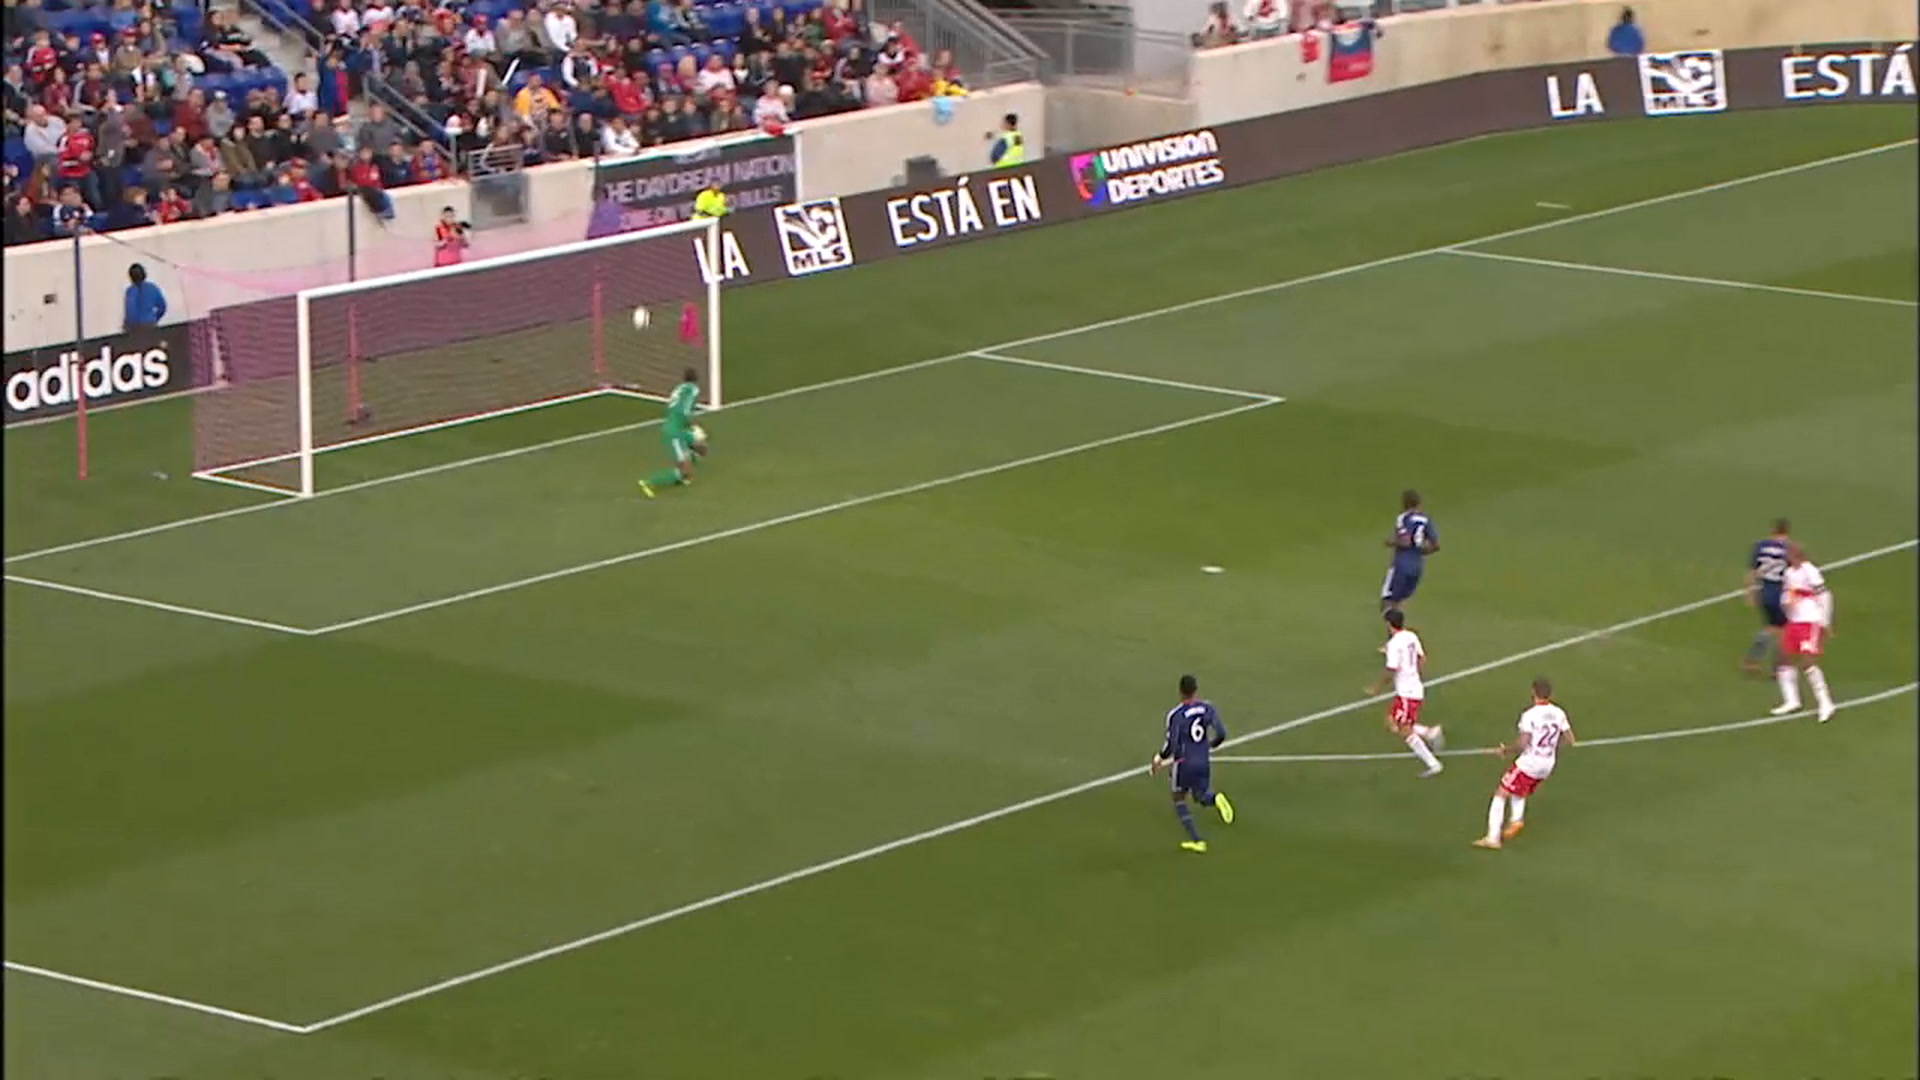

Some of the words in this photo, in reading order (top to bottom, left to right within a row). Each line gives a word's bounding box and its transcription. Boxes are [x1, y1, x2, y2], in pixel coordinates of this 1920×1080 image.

[1546, 71, 1605, 120] LA
[1652, 92, 1719, 109] MLS
[1780, 43, 1917, 100] ESTÁ
[1100, 130, 1218, 174] UNIVISION
[1106, 158, 1225, 205] DEPORTES
[693, 231, 751, 284] LA
[792, 245, 848, 271] MLS
[886, 175, 984, 248] ESTÁ
[988, 174, 1042, 228] EN
[5, 345, 170, 411] adidas
[1191, 717, 1205, 742] 6
[1537, 723, 1559, 748] 22
